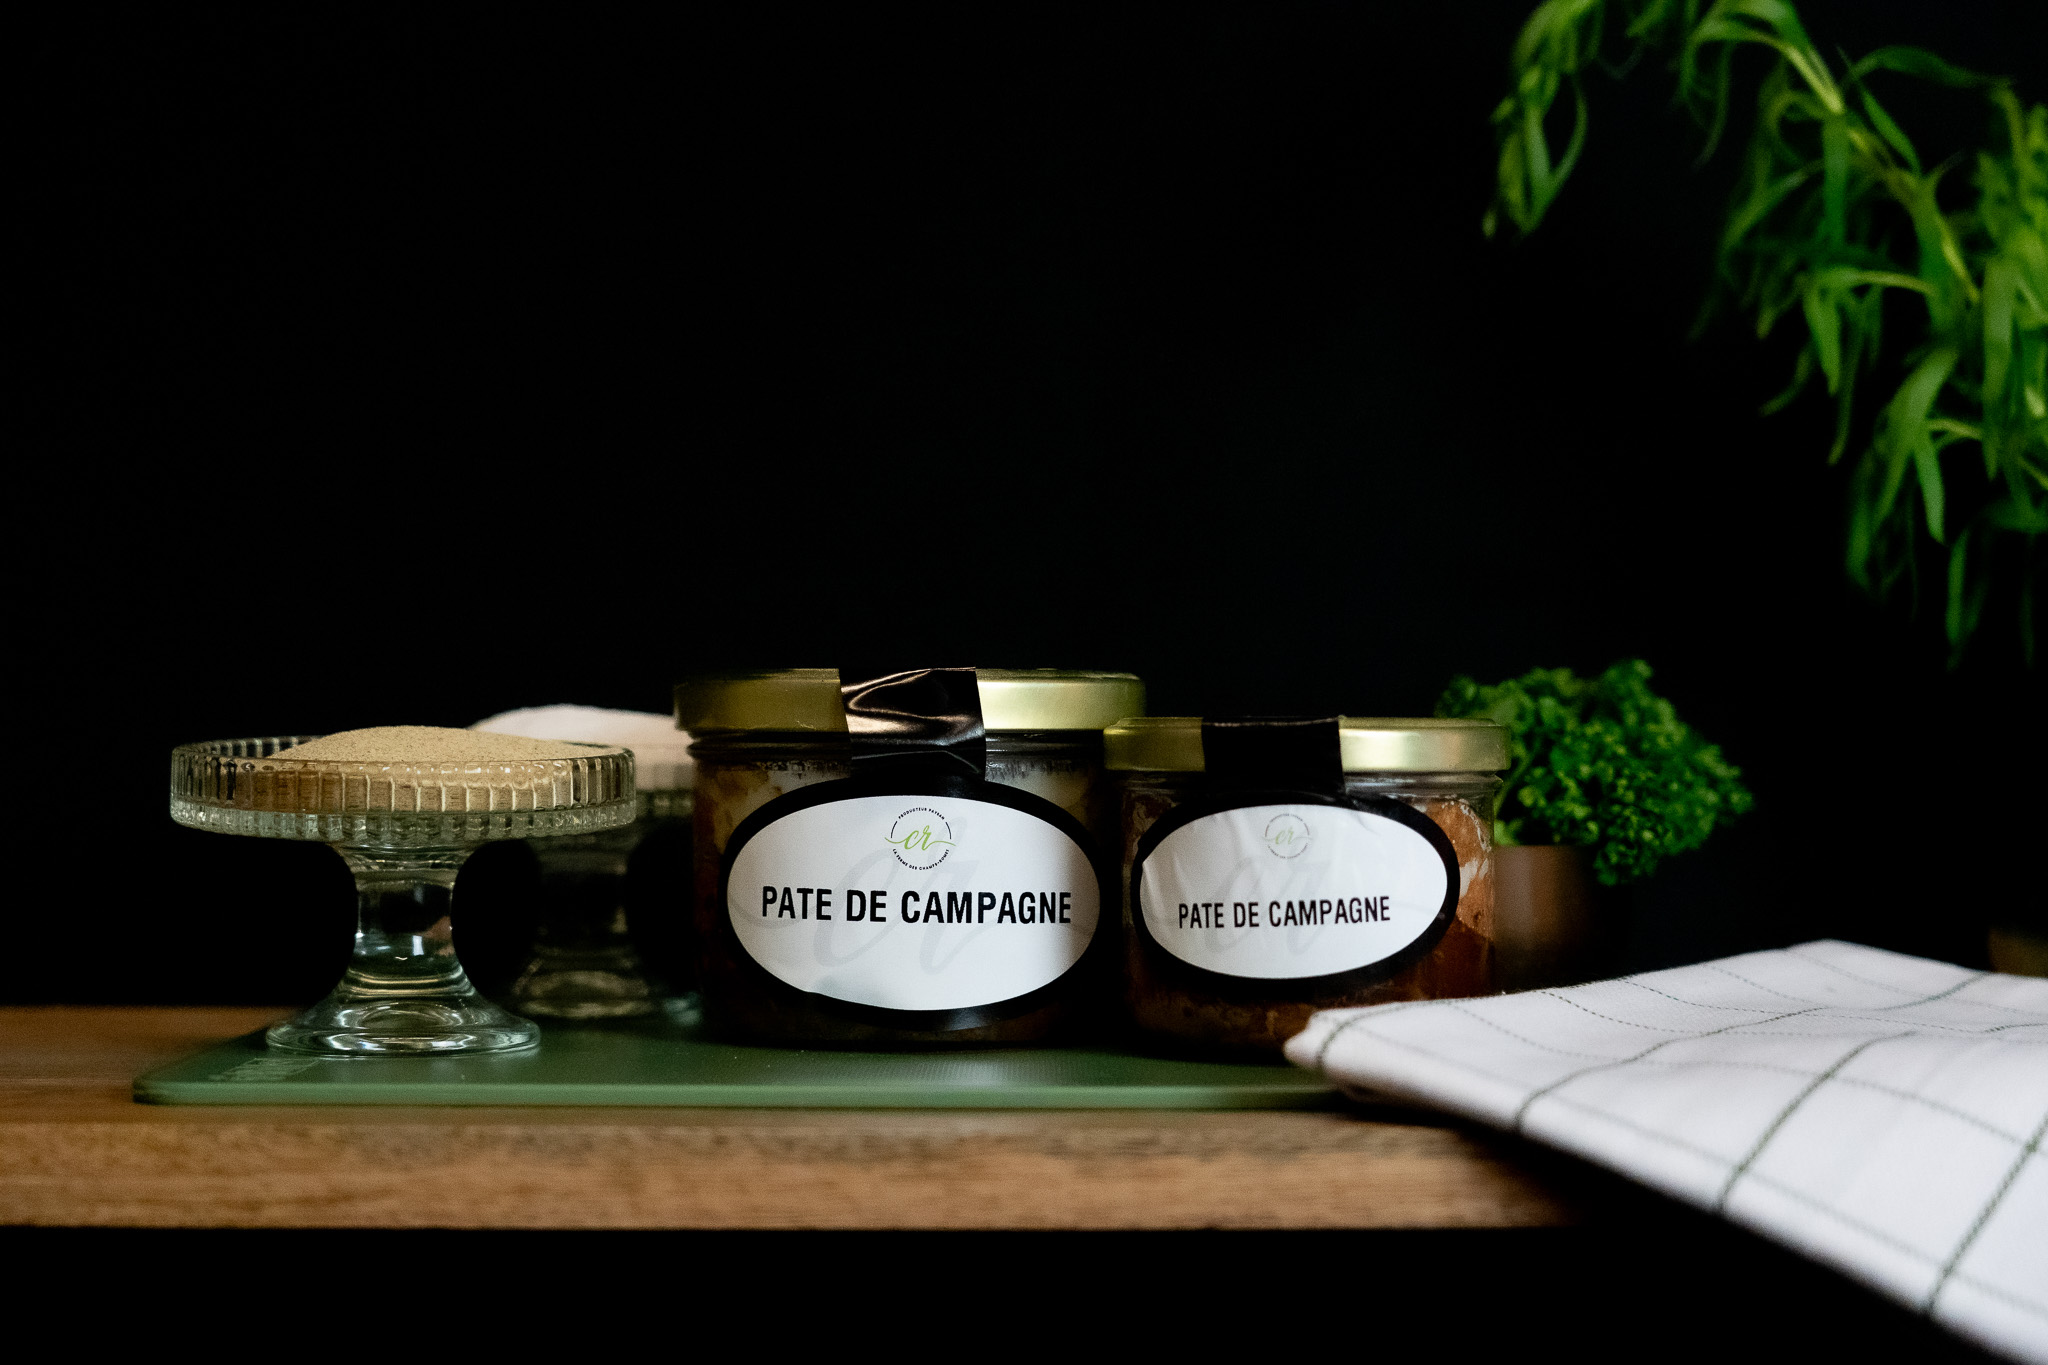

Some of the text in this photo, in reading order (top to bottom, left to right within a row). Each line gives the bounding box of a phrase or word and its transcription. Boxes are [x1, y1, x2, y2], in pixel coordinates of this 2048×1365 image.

[762, 886, 1072, 924] PATE DE CAMPAGNE
[1179, 896, 1391, 929] PATE DE CAMPAGNE
